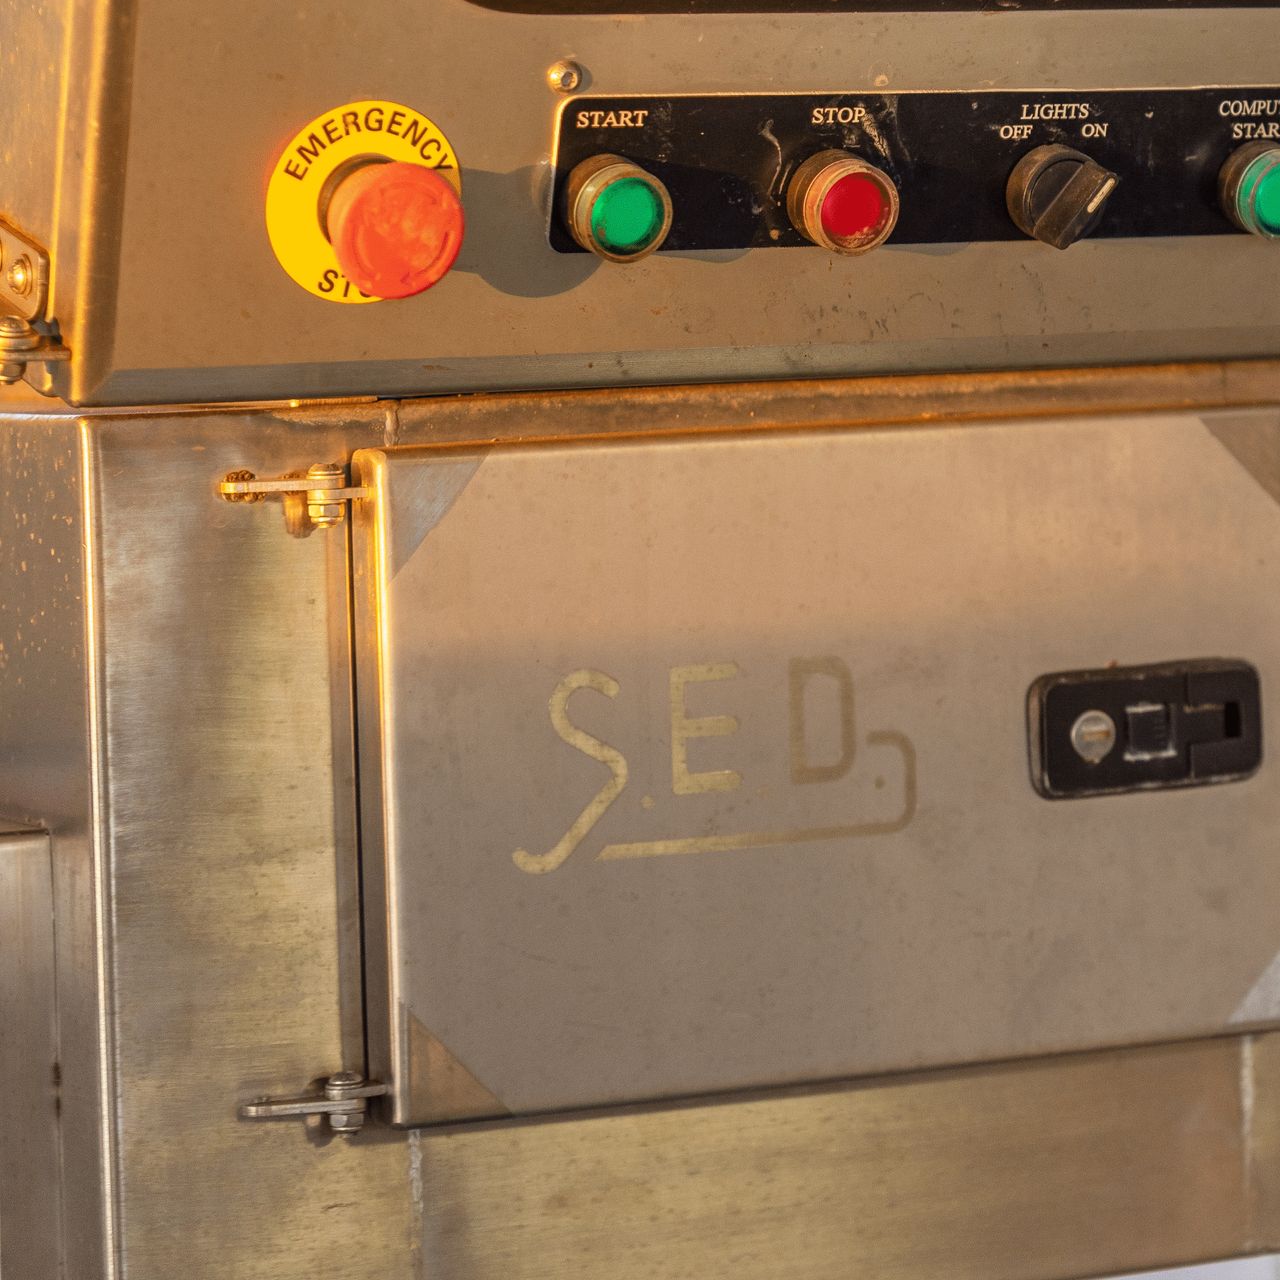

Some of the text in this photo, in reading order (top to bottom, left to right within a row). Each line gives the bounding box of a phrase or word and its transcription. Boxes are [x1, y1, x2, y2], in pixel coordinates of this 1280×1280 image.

[576, 110, 649, 128] START
[811, 107, 866, 124] STOP
[1021, 103, 1090, 120] LIGHTS
[1000, 123, 1109, 141] OFF ON
[284, 107, 453, 181] EMERGENCY
